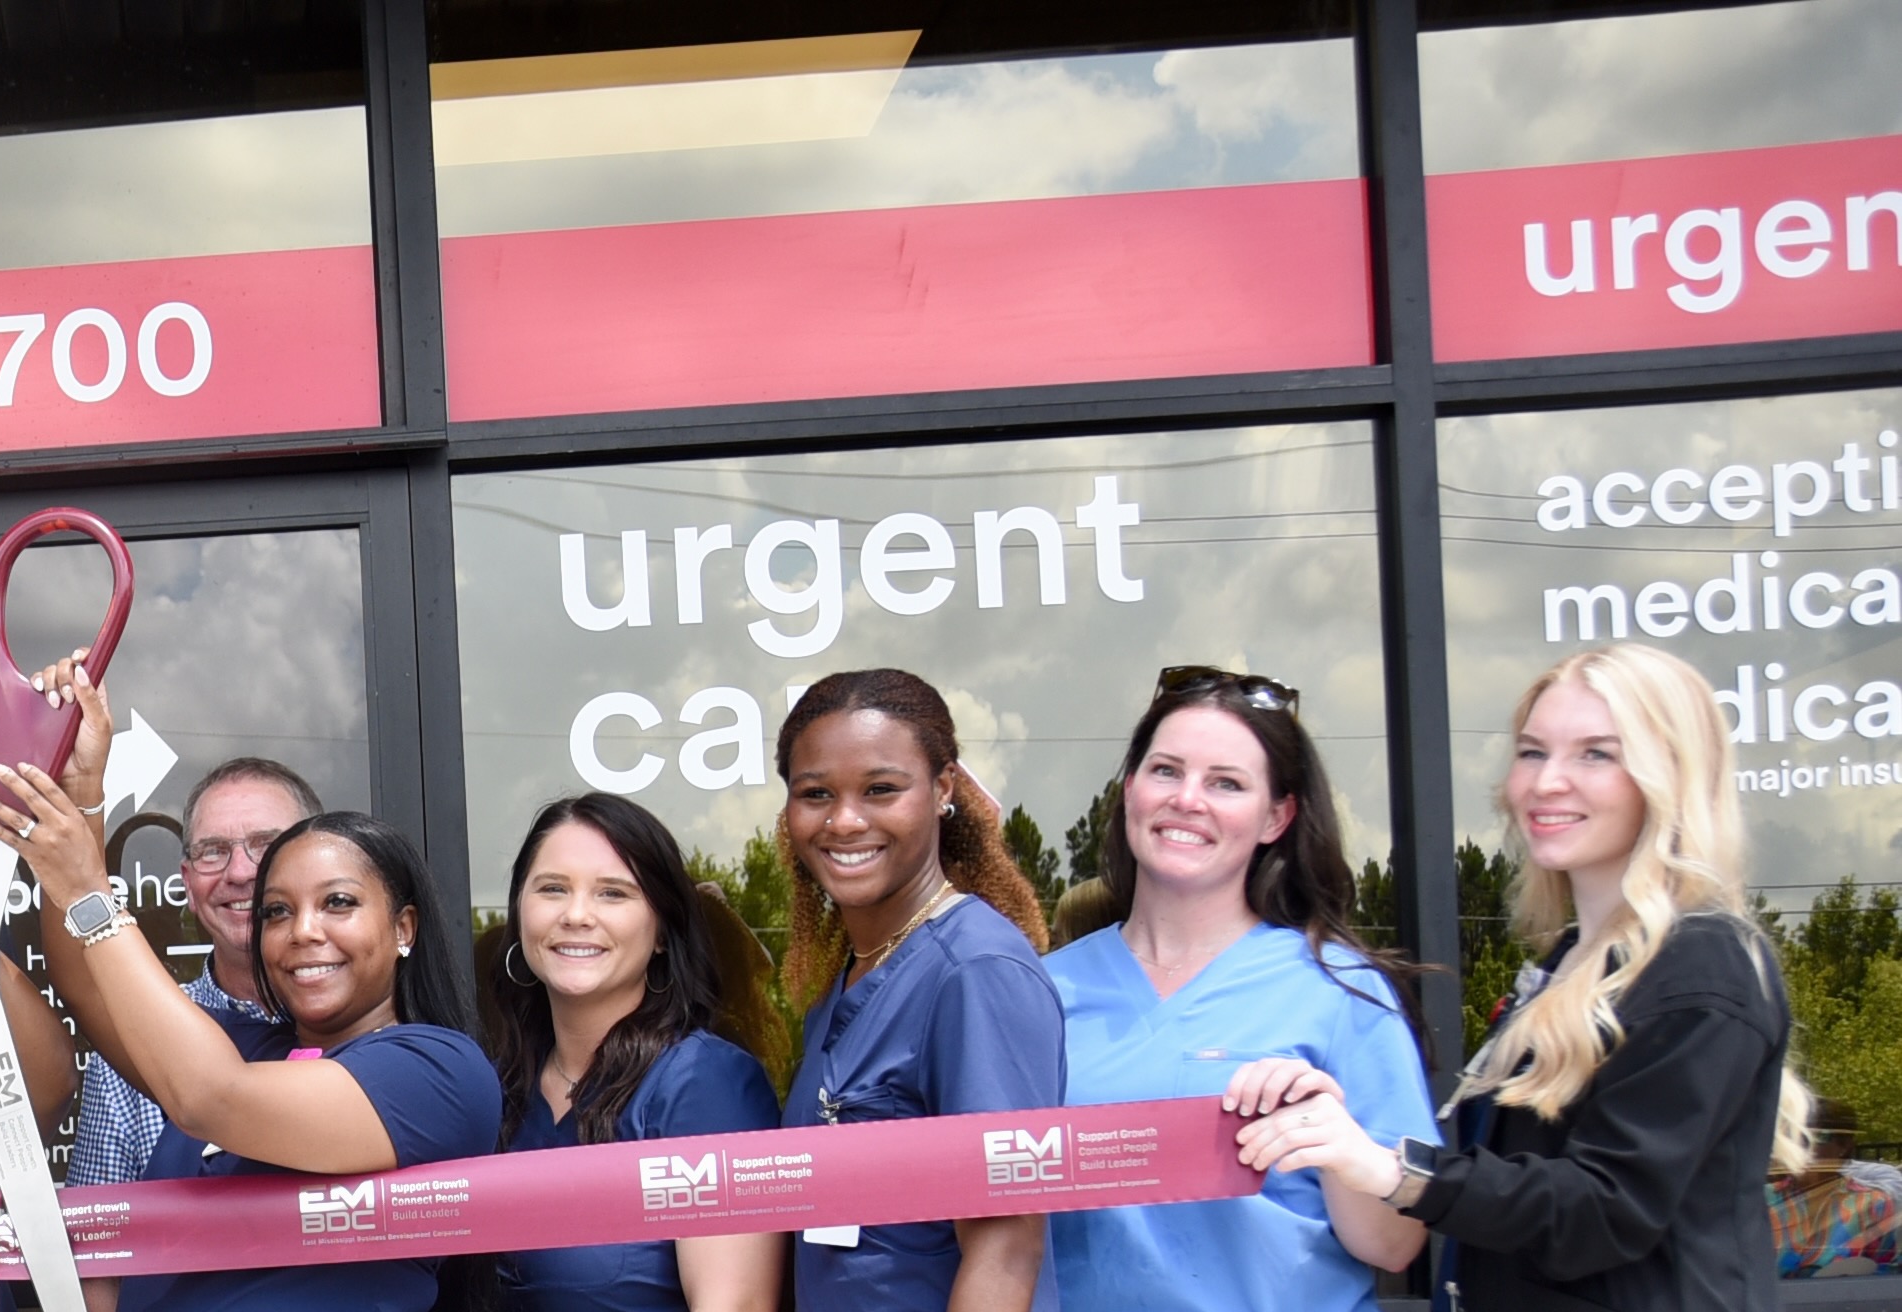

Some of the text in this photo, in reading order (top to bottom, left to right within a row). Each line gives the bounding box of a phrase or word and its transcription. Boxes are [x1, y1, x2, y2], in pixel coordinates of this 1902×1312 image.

[1536, 431, 1902, 537] accepti
[559, 475, 1145, 658] urgent
[1544, 551, 1902, 642] medica
[1724, 664, 1902, 743] dica
[568, 684, 807, 794] ca
[1735, 759, 1829, 797] major
[983, 1126, 1062, 1163] EM
[1077, 1127, 1158, 1143] Support Growth
[732, 1152, 812, 1169] Support Growth
[1078, 1142, 1158, 1156] Connect People
[639, 1152, 717, 1189] EM
[733, 1167, 813, 1182] Connect People
[987, 1159, 1064, 1185] BDC
[1080, 1157, 1148, 1171] Build Leaders
[299, 1179, 375, 1213] EM
[390, 1178, 469, 1194] Support Growth
[642, 1185, 719, 1210] BDC
[735, 1183, 803, 1197] Build Leaders
[94, 1202, 130, 1213] Growth
[391, 1192, 469, 1207] Connect People
[301, 1209, 376, 1233] BDC
[392, 1208, 460, 1221] Build Leaders
[82, 1230, 121, 1242] Leaders
